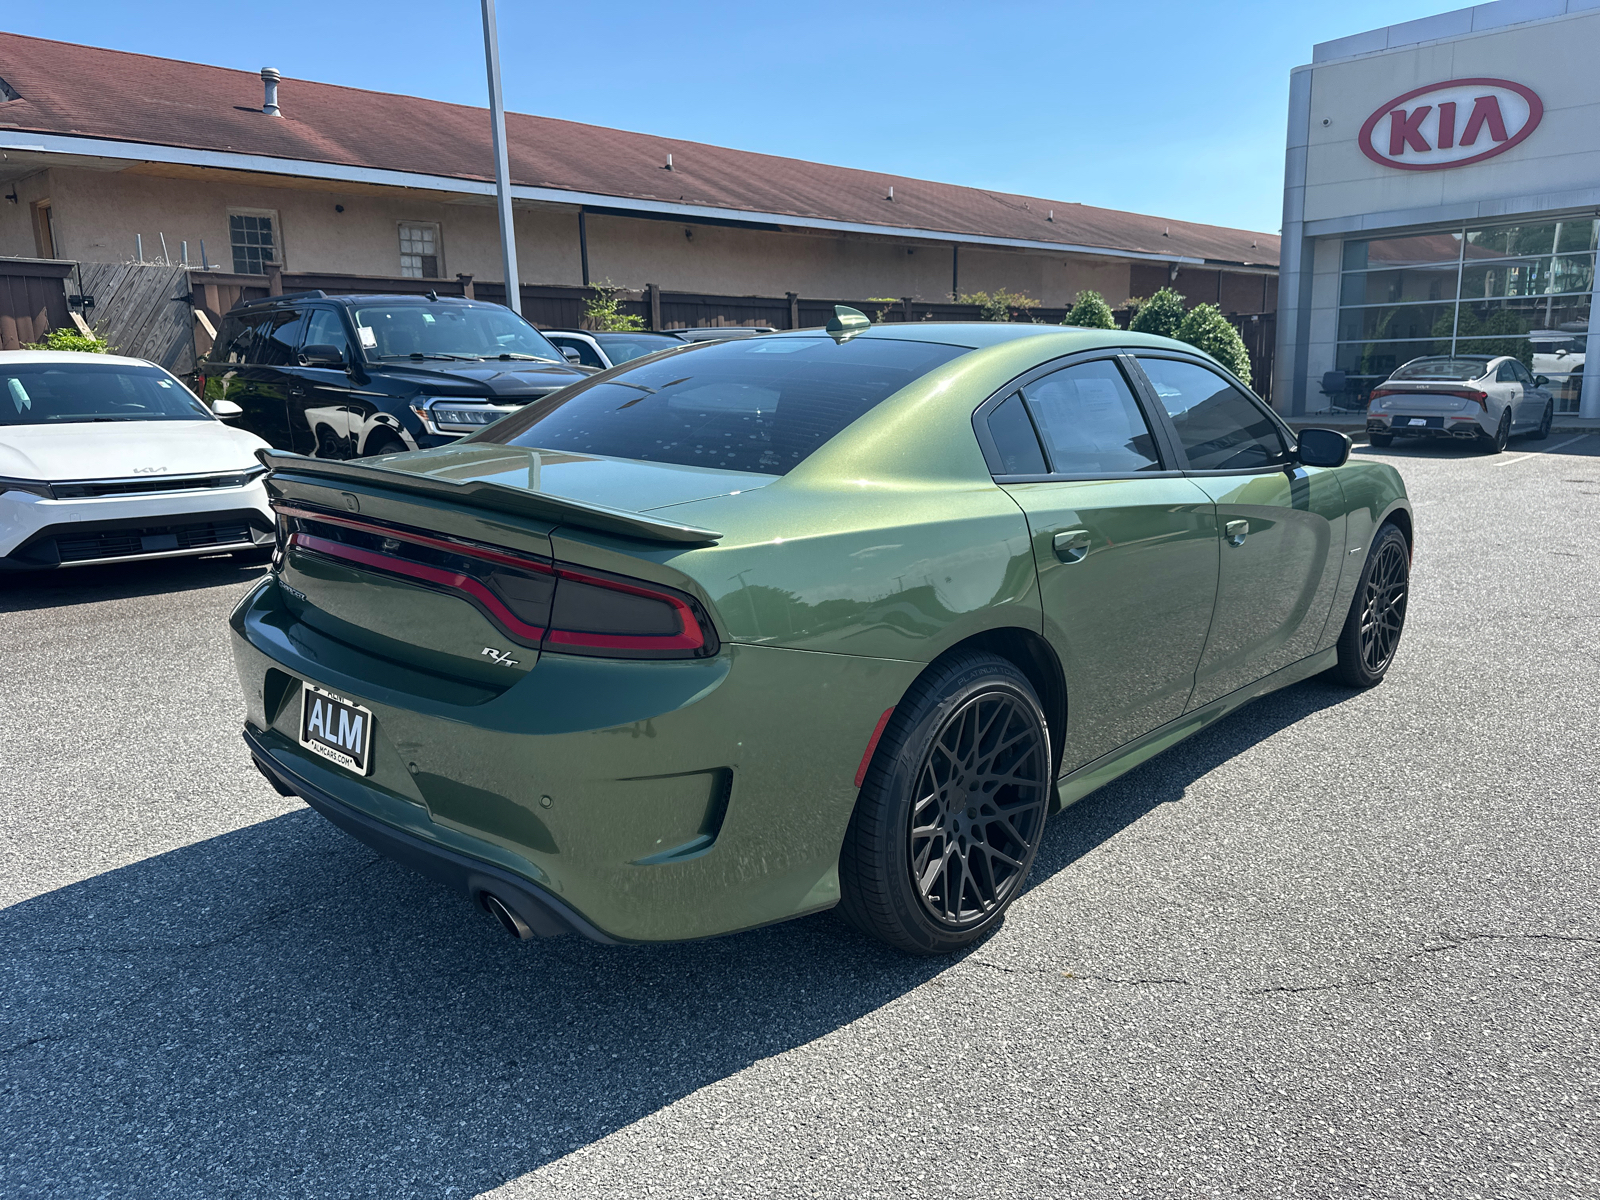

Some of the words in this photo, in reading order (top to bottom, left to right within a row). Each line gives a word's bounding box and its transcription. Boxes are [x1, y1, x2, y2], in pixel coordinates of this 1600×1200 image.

[1389, 95, 1508, 156] KIA
[481, 647, 518, 667] R/T
[308, 698, 363, 754] ALM
